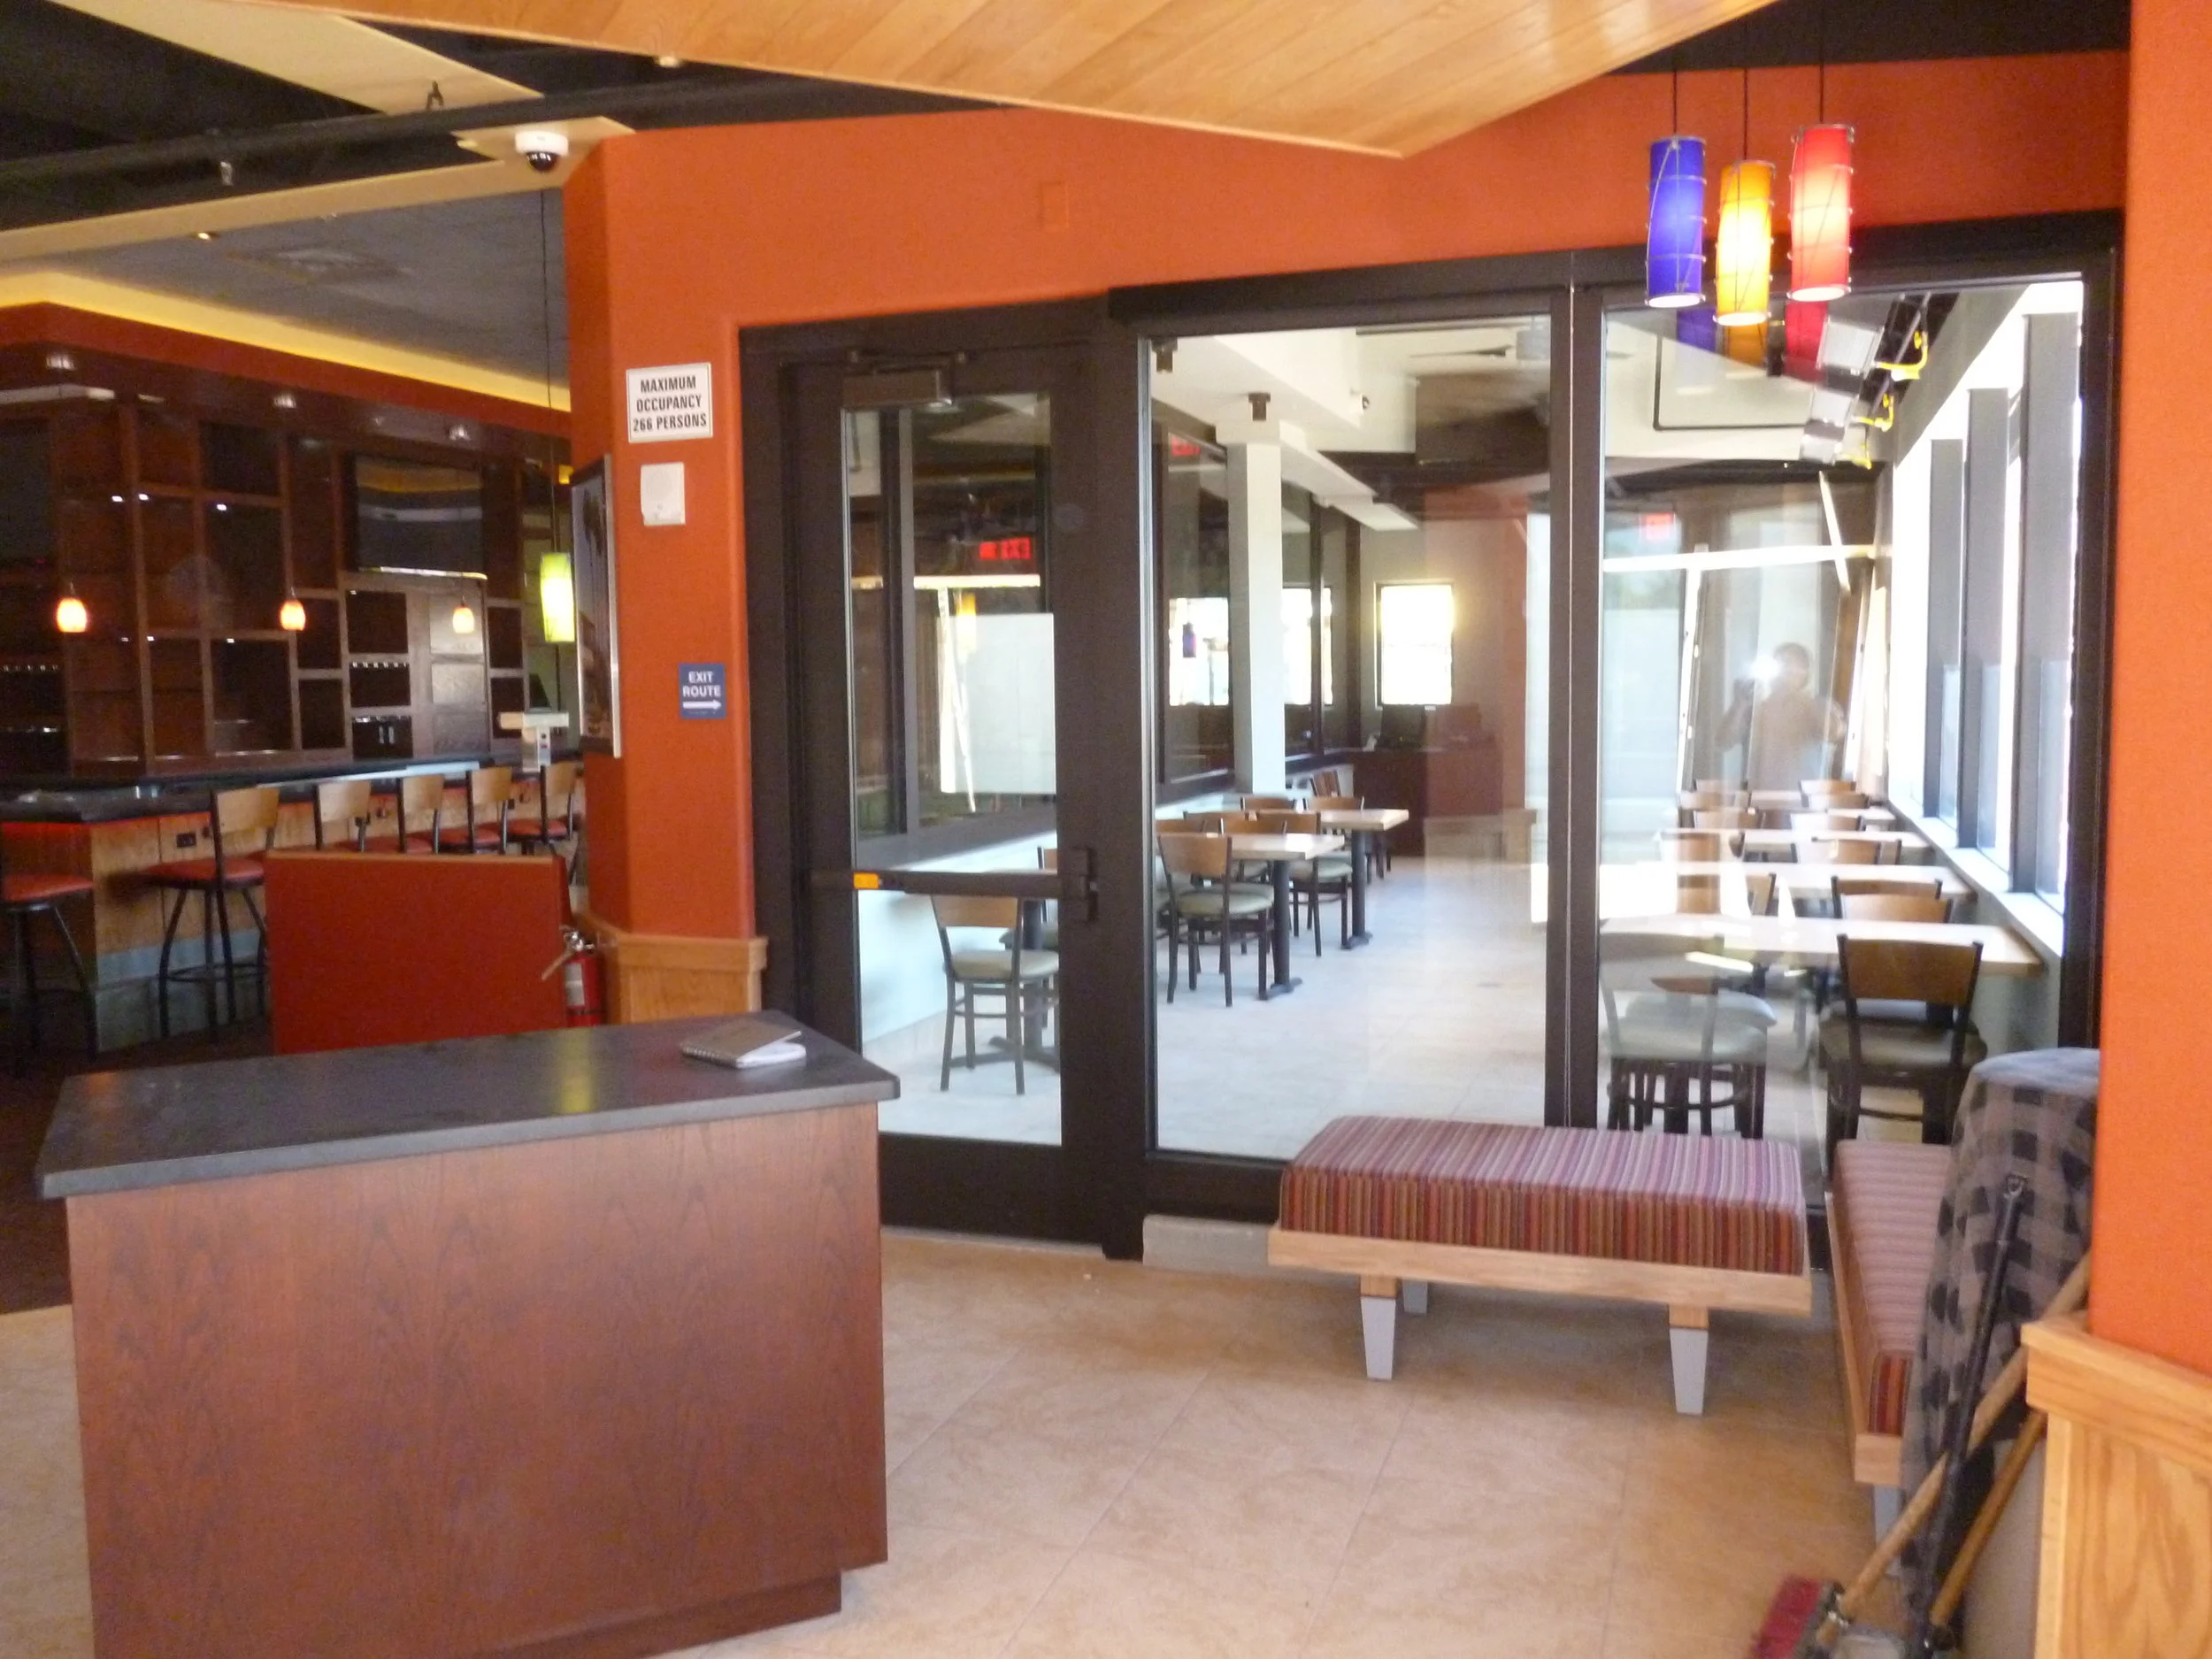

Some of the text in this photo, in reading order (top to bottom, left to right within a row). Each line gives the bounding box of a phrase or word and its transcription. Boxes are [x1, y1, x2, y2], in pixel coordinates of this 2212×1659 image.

[640, 375, 696, 393] MAXIMUM
[636, 395, 702, 413] OCCUPANCY
[633, 413, 707, 433] 266 PERSONS
[688, 671, 713, 684] EXIT
[682, 685, 721, 697] ROUTE
